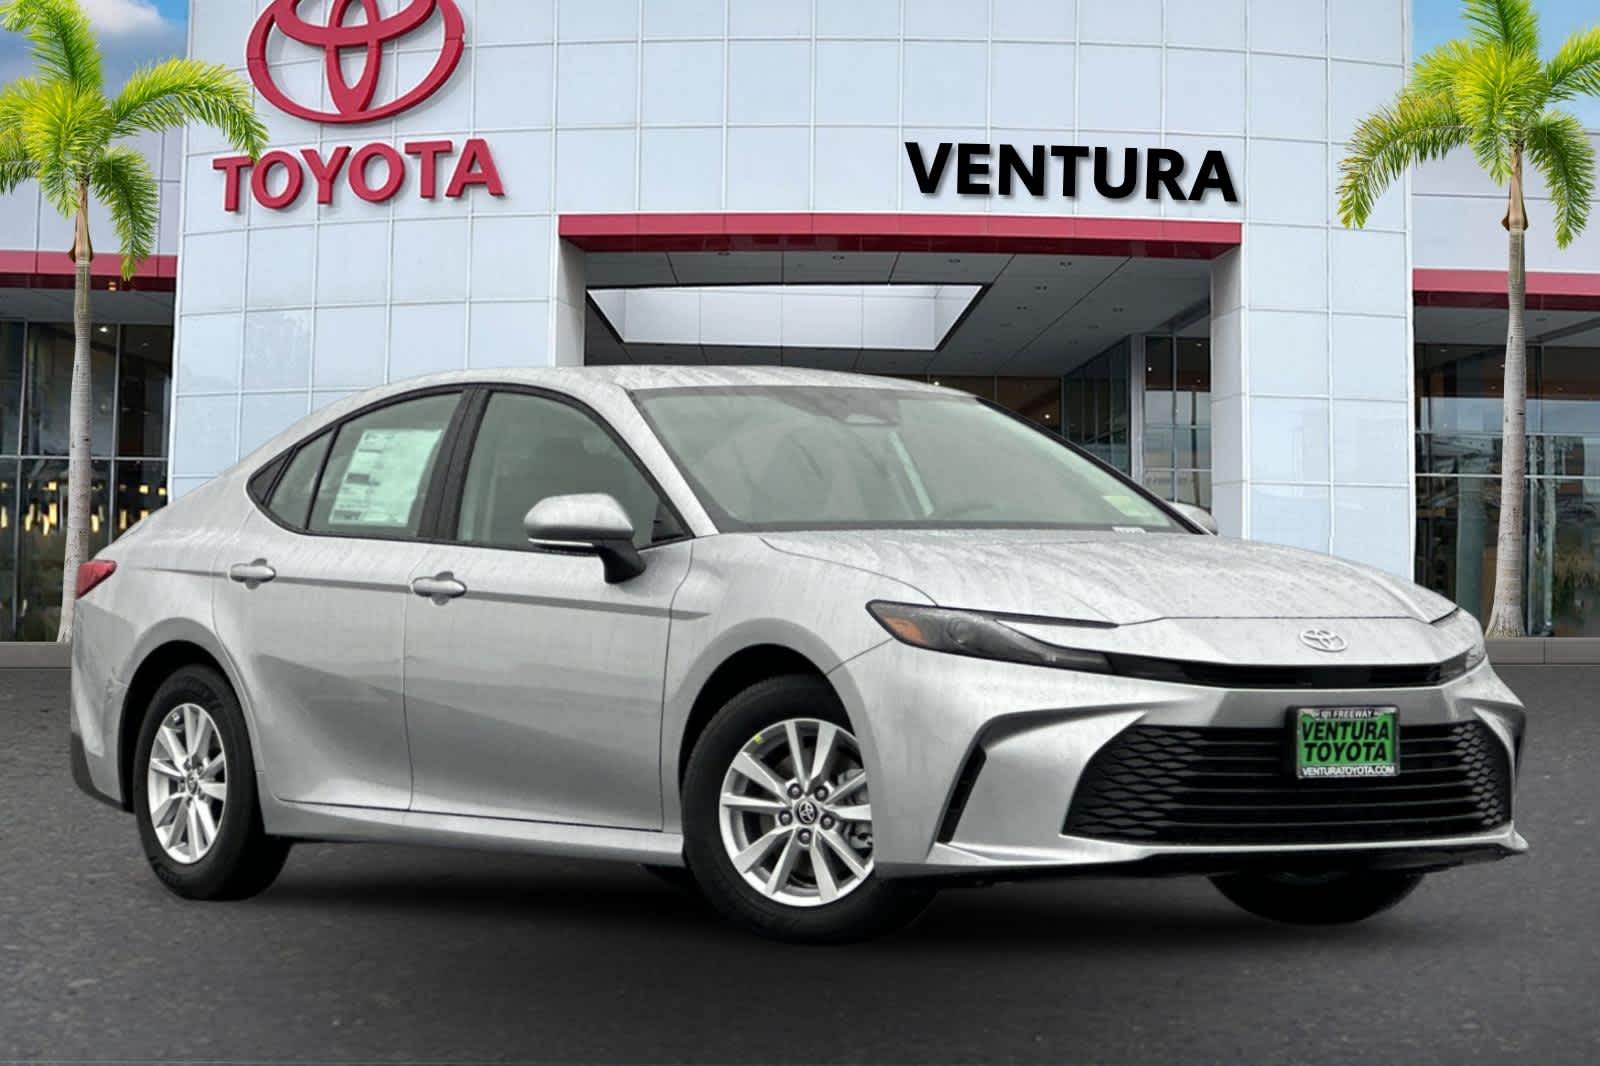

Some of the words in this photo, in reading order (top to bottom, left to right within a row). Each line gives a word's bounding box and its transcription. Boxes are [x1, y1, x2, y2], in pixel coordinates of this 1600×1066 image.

[213, 138, 505, 213] TOYOTA
[904, 142, 1238, 202] VENTURA
[1302, 721, 1389, 740] VENTURA
[1304, 742, 1387, 762] TOYOTA
[1302, 766, 1394, 776] VENTURATOYOTA.COM
